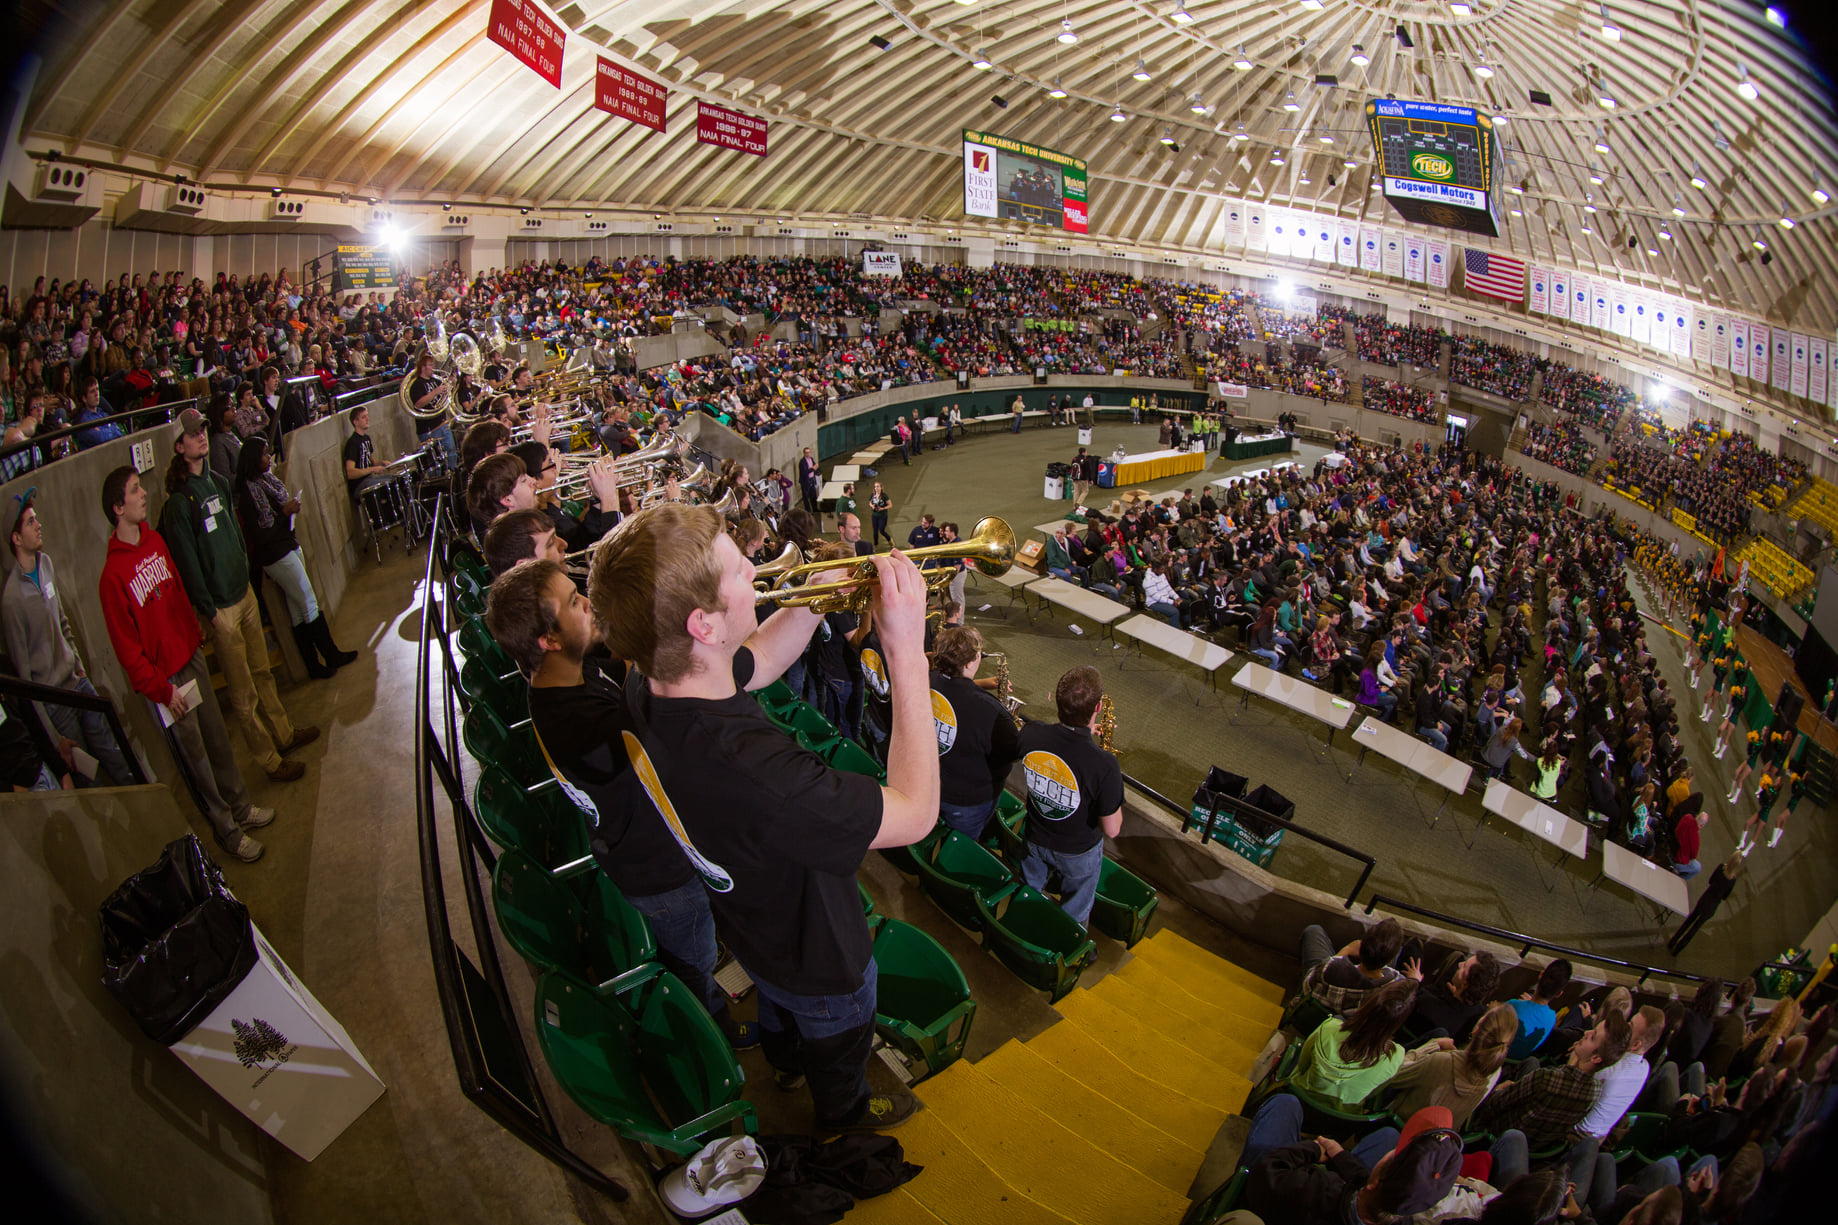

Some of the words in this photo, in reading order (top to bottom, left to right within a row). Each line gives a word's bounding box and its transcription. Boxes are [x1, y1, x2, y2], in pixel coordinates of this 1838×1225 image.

[524, 3, 537, 24] TECH
[536, 16, 553, 39] GOLDEN
[498, 22, 515, 46] NAIA
[518, 38, 536, 62] FINAL
[539, 55, 555, 77] FOUR
[598, 62, 622, 81] ARKANSAS
[624, 74, 636, 88] TECH
[636, 80, 654, 96] GOLDEN
[656, 88, 666, 102] SUNS
[603, 94, 619, 109] NAIA
[622, 101, 641, 118] FINAL
[643, 110, 660, 125] FOUR
[700, 106, 724, 120] ARKANSAS
[726, 112, 737, 124] TECH
[738, 116, 754, 128] GOLDEN
[1378, 104, 1404, 116] AQUAFINA
[1438, 106, 1458, 114] perfect
[700, 130, 718, 142] NAIA
[721, 134, 743, 148] FINAL
[745, 140, 765, 152] FOUR
[982, 135, 1020, 151] ARKANSAS
[1022, 144, 1038, 156] TECH
[1039, 150, 1074, 166] UNIVERSITY
[1420, 160, 1447, 173] TECH
[969, 172, 992, 188] FIRST
[1395, 180, 1438, 194] Cogswell
[1440, 185, 1474, 200] Motors
[968, 186, 994, 200] STATE
[972, 199, 992, 210] Bank
[869, 254, 896, 262] LANE
[129, 555, 173, 607] WARRIOR
[1024, 766, 1076, 807] TECH
[1044, 768, 1058, 780] OUT
[1060, 776, 1074, 788] FOR
[1195, 806, 1230, 824] RECCLE
